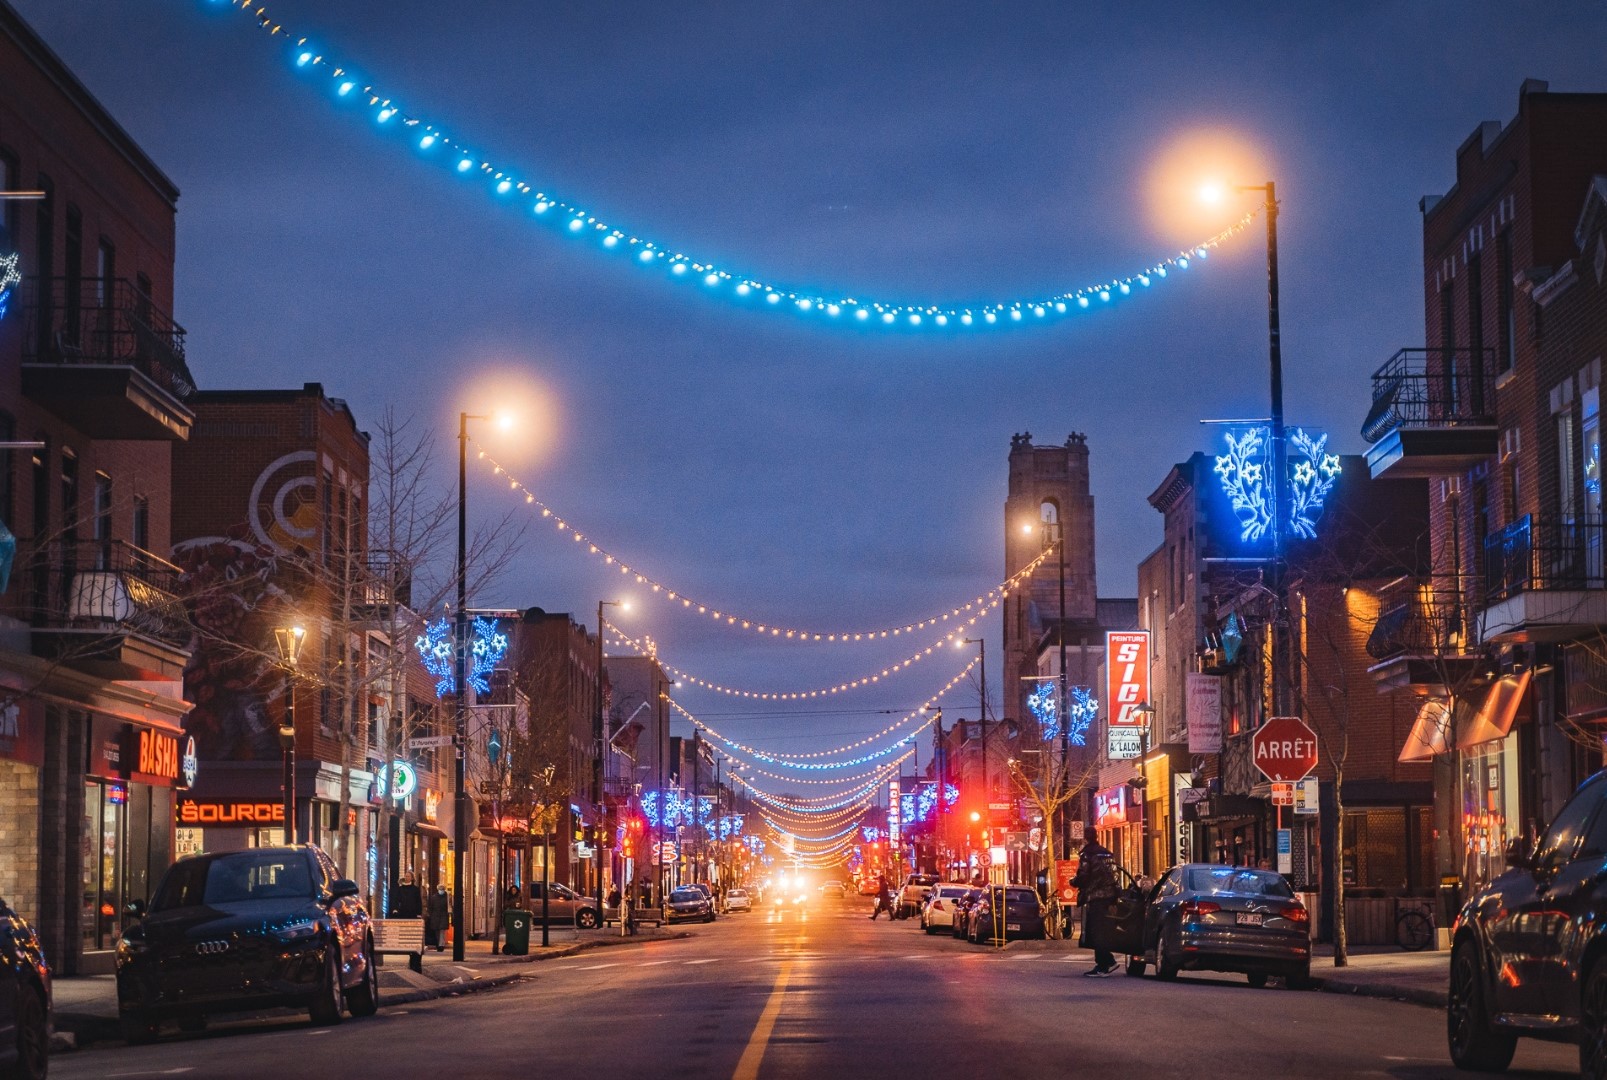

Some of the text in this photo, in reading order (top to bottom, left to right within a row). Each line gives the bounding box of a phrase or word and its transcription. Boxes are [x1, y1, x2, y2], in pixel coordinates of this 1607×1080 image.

[140, 728, 178, 778] BASHA
[1257, 738, 1314, 758] ARRÊT
[181, 804, 285, 822] SOURCE
